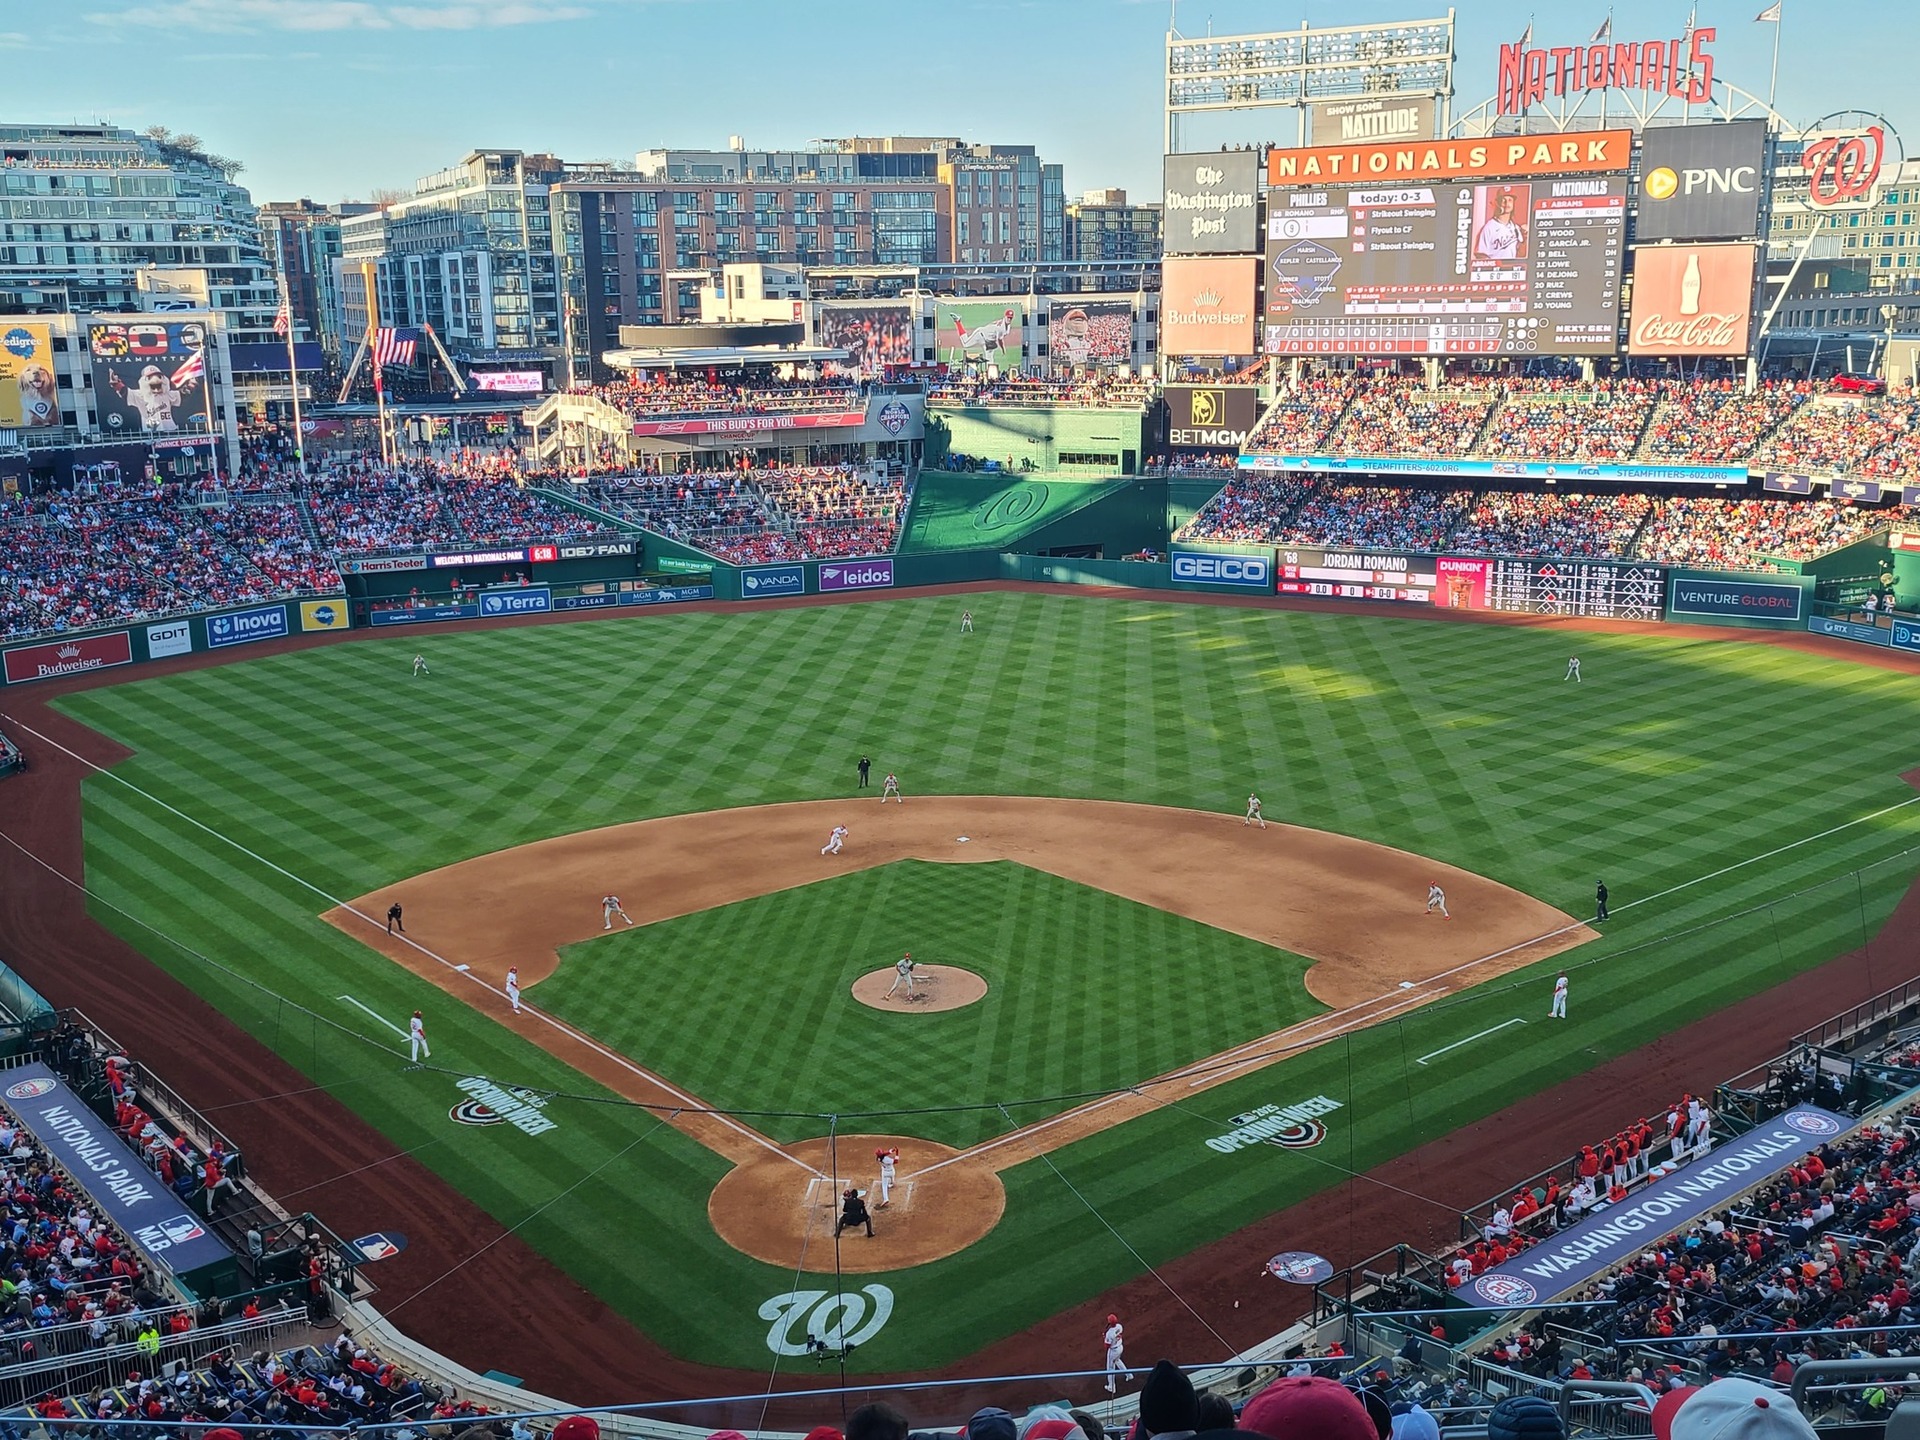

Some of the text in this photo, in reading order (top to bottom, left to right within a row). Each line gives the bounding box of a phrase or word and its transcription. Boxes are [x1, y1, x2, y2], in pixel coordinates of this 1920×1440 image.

[1497, 28, 1716, 115] NATIONALS
[1326, 102, 1382, 116] SHOW SOME
[1341, 107, 1419, 139] NATITUDE
[1279, 139, 1611, 177] NATIONALS PARK
[1195, 166, 1224, 187] The
[1681, 166, 1756, 195] PNC
[1552, 181, 1608, 197] NATIONALS
[1166, 188, 1254, 213] Washington
[1289, 192, 1328, 207] PHILLIES
[1360, 192, 1421, 204] today: 0-3
[1551, 200, 1583, 208] ABRAMS
[1371, 209, 1436, 218] Strikeout Swinging
[1191, 215, 1227, 239] Post
[1371, 225, 1413, 235] Flyout CF
[1549, 229, 1575, 237] WOOD
[1370, 242, 1435, 251] Strikeout Swinging
[1548, 250, 1567, 258] BELL
[1547, 260, 1570, 268] LOWE
[1606, 259, 1615, 267] 1B
[1547, 271, 1578, 279] DEJONG
[1534, 281, 1545, 289] 20
[1546, 281, 1564, 289] RUIZ
[1545, 290, 1613, 299] CREWS RF
[1545, 301, 1572, 309] YOUNG
[1601, 301, 1613, 309] CF
[1167, 309, 1248, 325] Budweiser
[1507, 319, 1515, 328] B
[1508, 331, 1515, 339] S
[1635, 313, 1744, 347] Coca-Cola
[1555, 335, 1612, 343] NATITUDE
[706, 415, 797, 431] THIS BUD'S FOR YOU.
[155, 440, 179, 448] ADVANCE
[1170, 429, 1247, 445] BETMGM
[1328, 461, 1459, 473] MCA STEAMFITTERS-602.ORG
[1577, 468, 1728, 480] MCA STEAMFITTERS-602.ORG
[534, 549, 552, 559] 6:18
[598, 544, 631, 555] FAN
[361, 559, 425, 571] Harris Teeter
[434, 551, 524, 566] WELCOME TO NATIONALS PARK
[1322, 553, 1408, 571] JORDAN ROMANO
[1174, 556, 1266, 580] GEICO
[1439, 561, 1484, 572] DUNKIN'
[758, 575, 800, 586] VANDA
[843, 568, 891, 585] leidos
[608, 583, 619, 591] 377
[681, 588, 699, 596] MGM
[1315, 584, 1327, 594] 0.0
[1378, 589, 1391, 598] 0-0
[503, 596, 545, 609] Terra
[580, 597, 605, 606] CLEAR
[1680, 591, 1793, 609] VENTURE GLOBAL
[233, 612, 282, 632] Inova
[1833, 624, 1847, 633] RTX
[150, 627, 188, 642] GDIT
[456, 1075, 558, 1136] OPENING WEEK
[1252, 1103, 1280, 1117] 2025
[1205, 1095, 1345, 1153] OPENING WEEK
[39, 1105, 153, 1207] NATIONALS PARK
[1522, 1131, 1801, 1279] WASHINGTON NATIONALS
[133, 1224, 173, 1253] MLB
[758, 1283, 895, 1357] W
